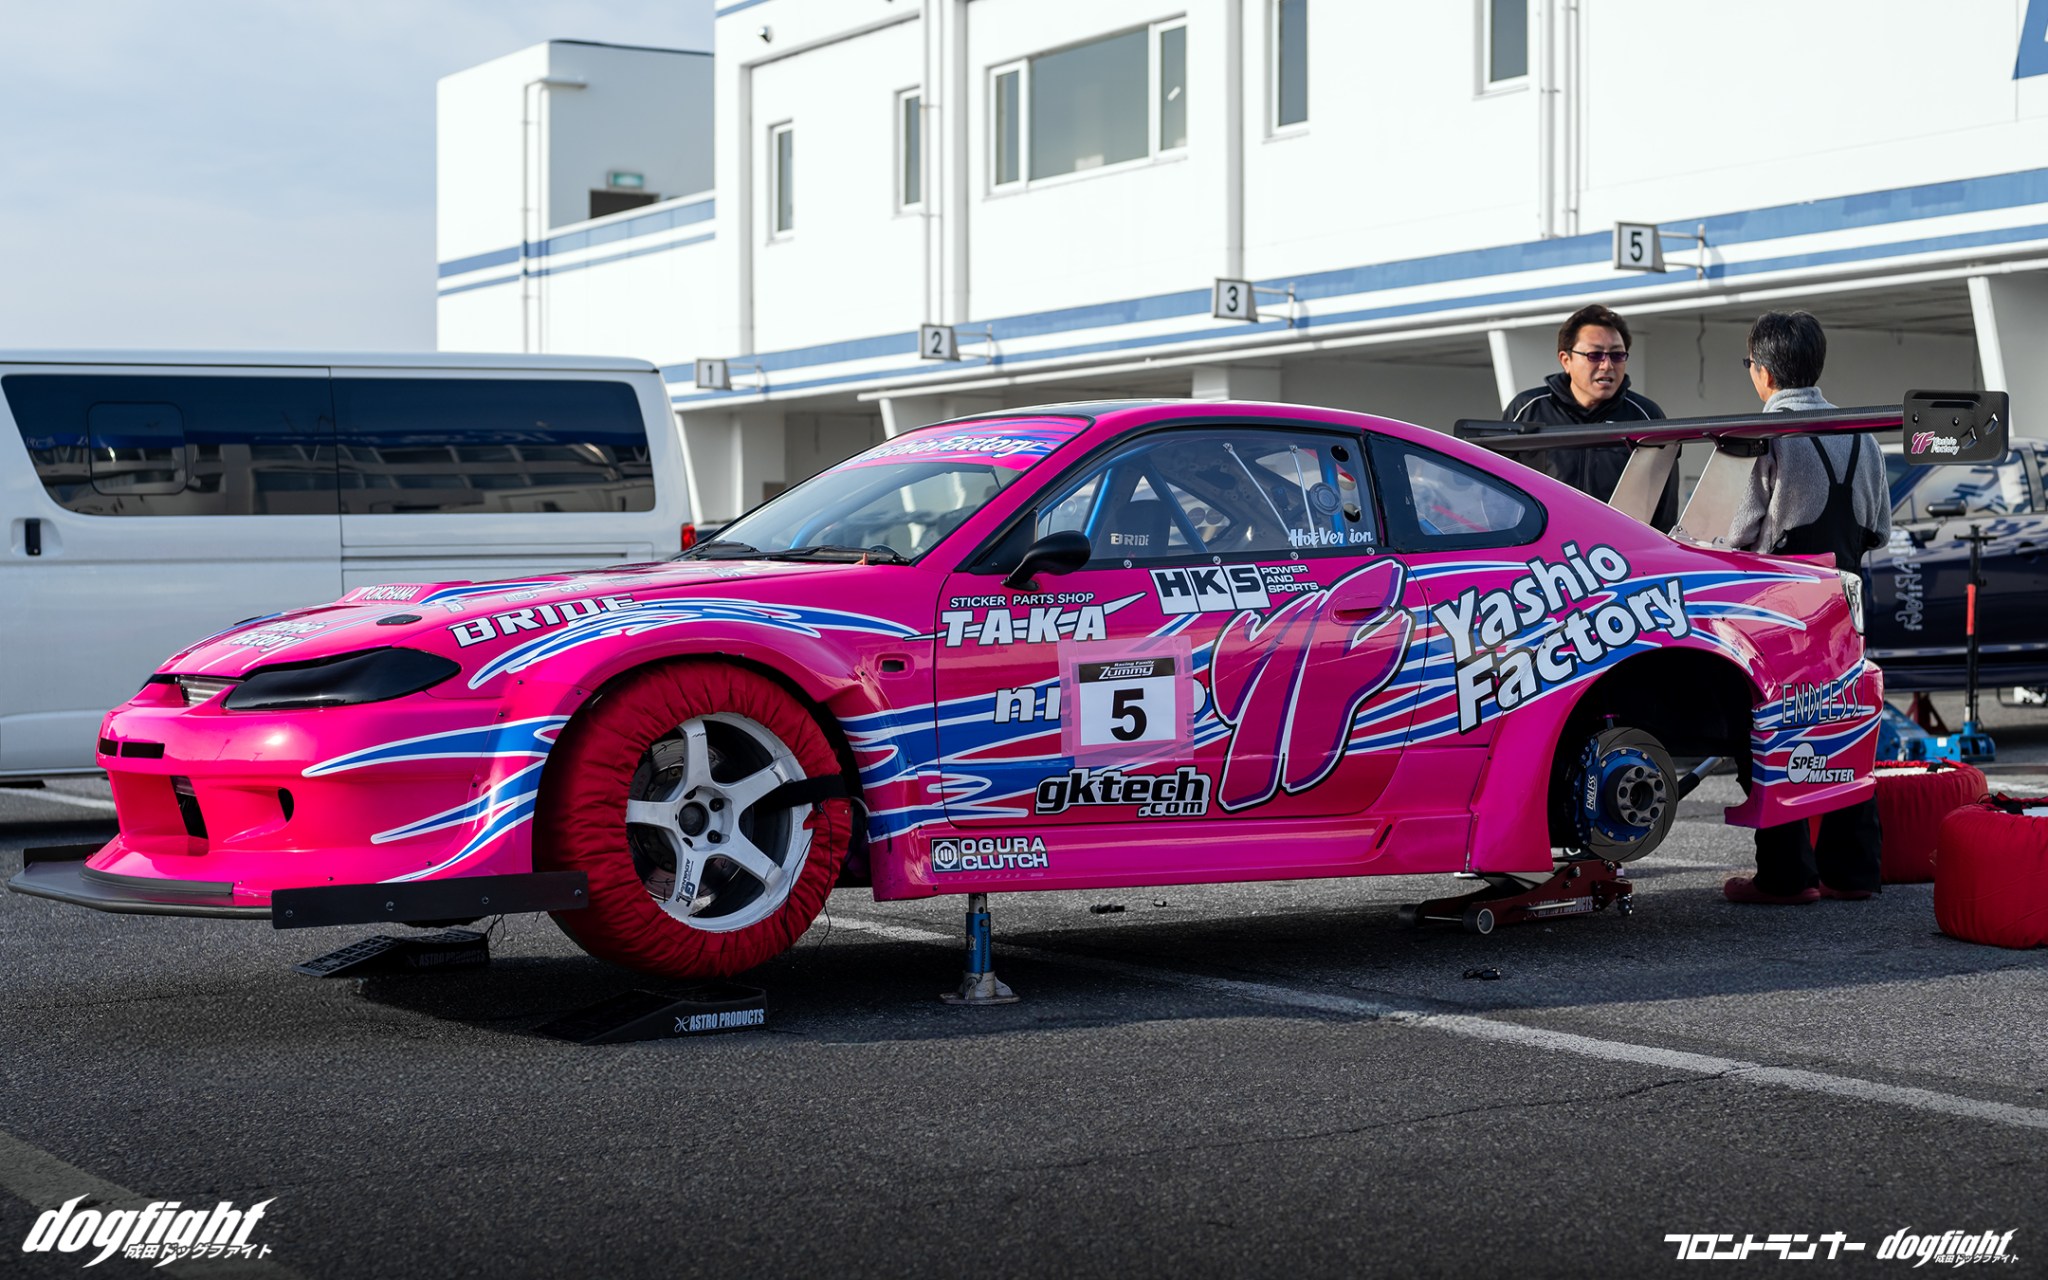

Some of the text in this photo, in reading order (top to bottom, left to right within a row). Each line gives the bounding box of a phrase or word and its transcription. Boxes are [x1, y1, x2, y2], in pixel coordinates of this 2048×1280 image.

[1630, 231, 1643, 262] 5
[1226, 286, 1239, 312] 3
[930, 331, 943, 354] 2
[705, 364, 714, 384] 1
[1260, 565, 1309, 576] POWER
[1266, 575, 1293, 584] AND
[1152, 565, 1267, 607] HKS
[1267, 582, 1318, 594] SPORTS
[950, 592, 1094, 608] STICKER PARTS SHOP
[1432, 540, 1630, 664] Yashio
[447, 593, 645, 648] BRIDE
[1456, 577, 1691, 735] Factory
[1781, 677, 1860, 724] ENDLESS
[1110, 688, 1147, 741] 5
[1790, 755, 1829, 770] SPEED
[1807, 768, 1855, 783] MASTER
[1035, 766, 1211, 815] gktech
[1585, 774, 1597, 811] ENDLESS
[1137, 800, 1209, 817] .com
[960, 837, 1046, 853] OGURA
[960, 852, 1048, 870] CLUTCH
[689, 1008, 765, 1031] ASTRO PRODUCTS
